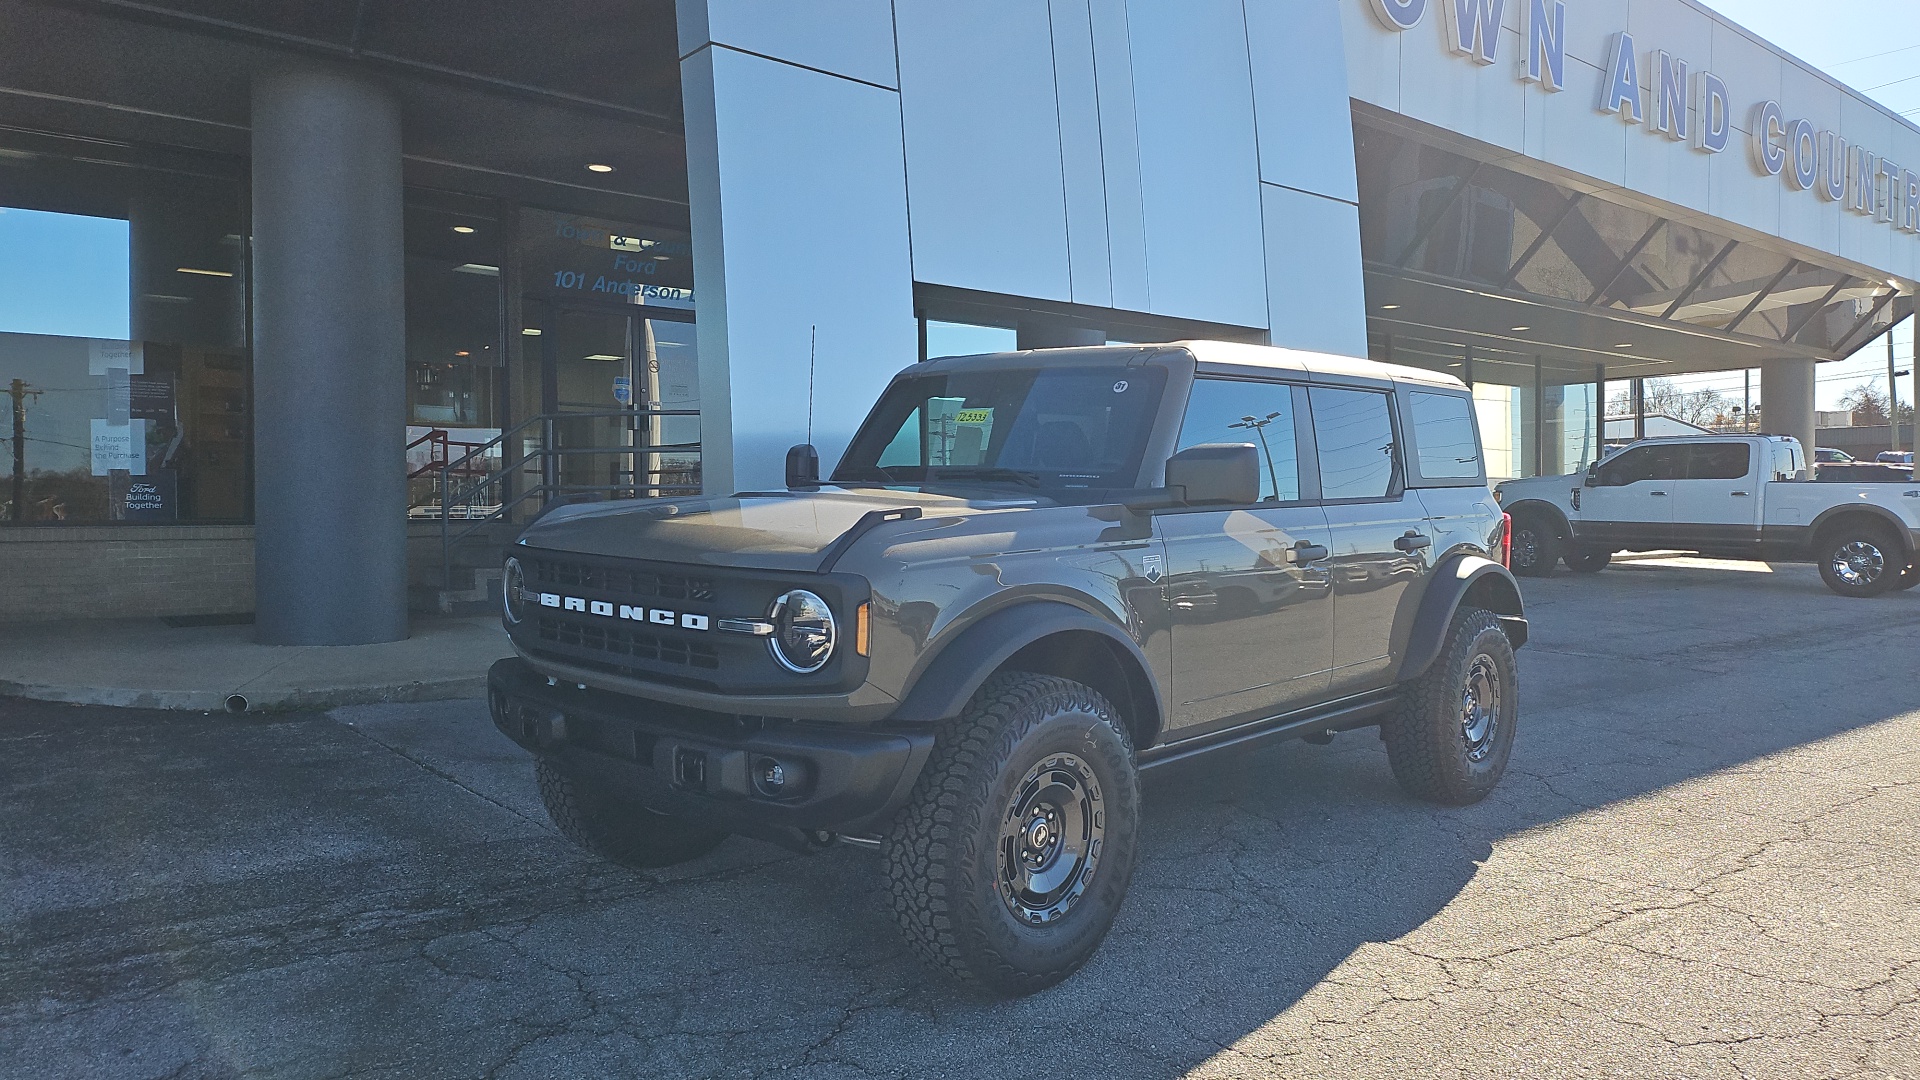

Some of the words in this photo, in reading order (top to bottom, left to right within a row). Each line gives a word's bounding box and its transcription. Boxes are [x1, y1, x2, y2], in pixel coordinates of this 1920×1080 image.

[1369, 0, 1565, 92] WN
[1600, 31, 1731, 154] AND
[1752, 100, 1920, 233] COUNTR
[613, 230, 628, 247] &
[613, 254, 657, 275] Ford
[554, 270, 586, 289] 101
[592, 275, 681, 301] Anderson
[102, 435, 130, 444] Purpose
[130, 483, 157, 493] Ford
[125, 501, 163, 510] Together
[126, 493, 161, 502] Building
[540, 592, 710, 631] BRONCO
